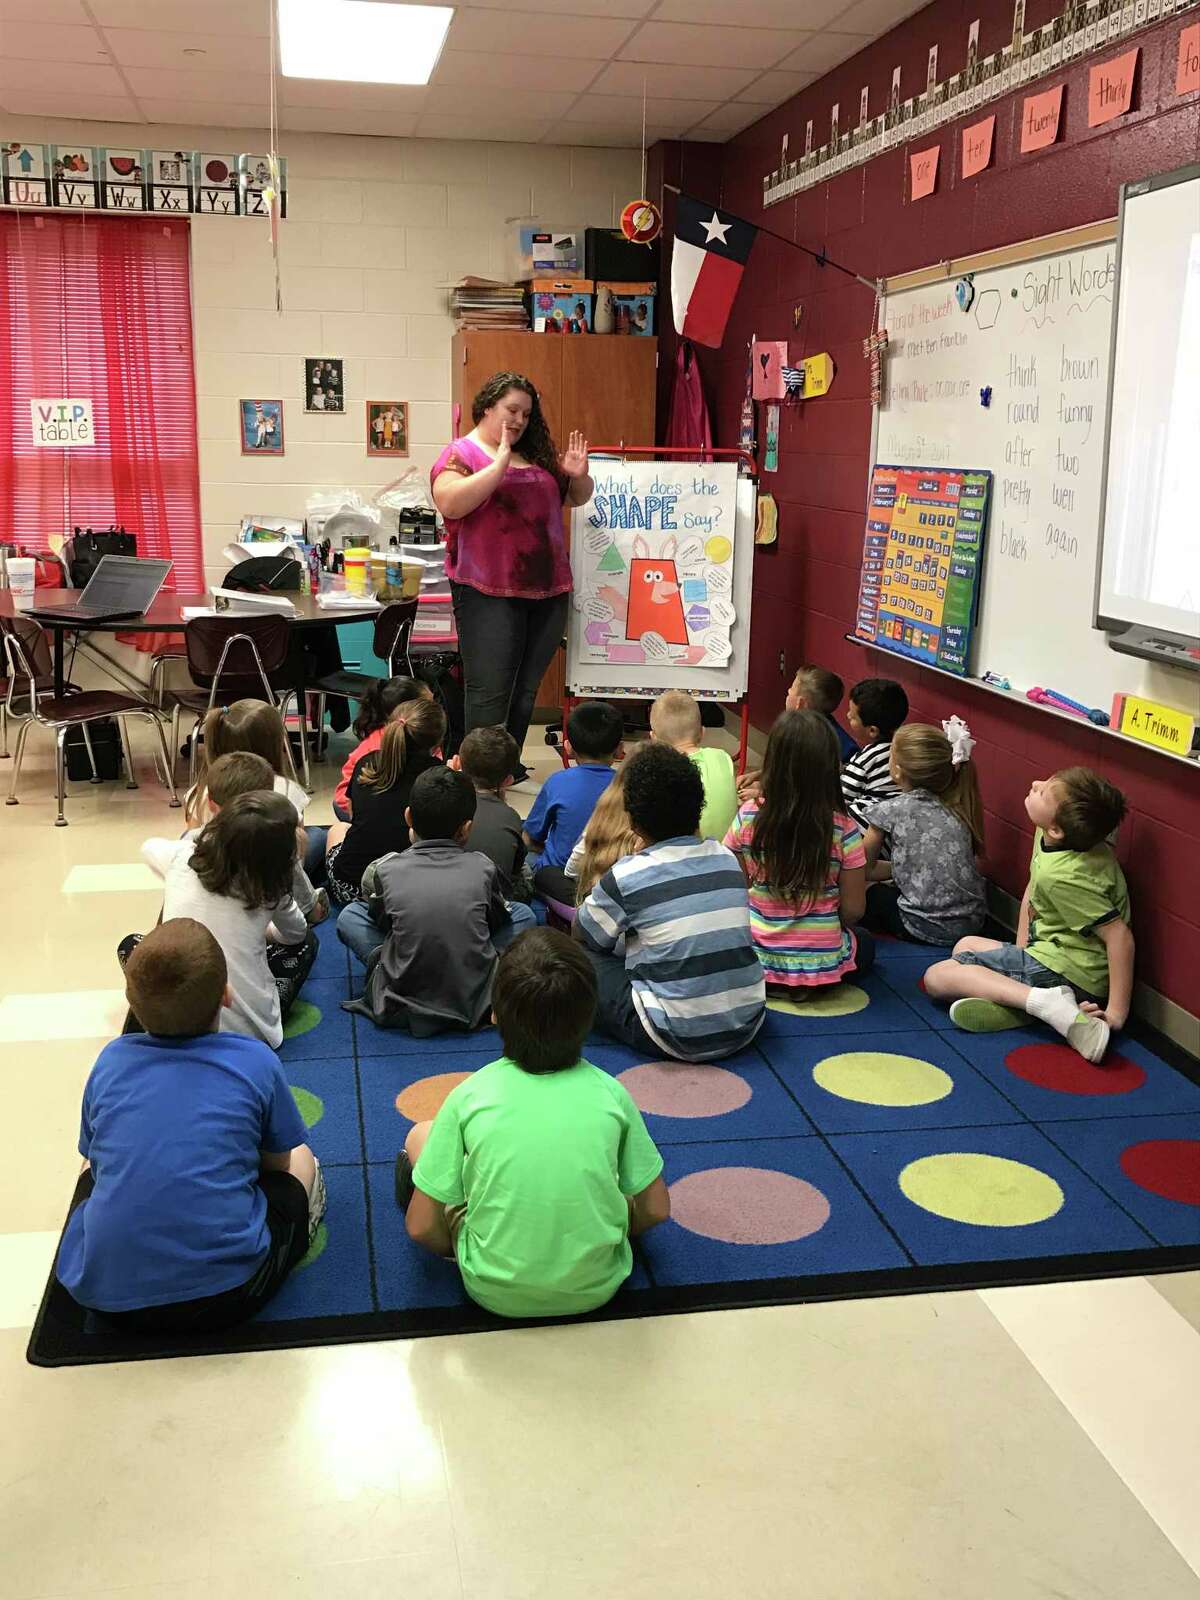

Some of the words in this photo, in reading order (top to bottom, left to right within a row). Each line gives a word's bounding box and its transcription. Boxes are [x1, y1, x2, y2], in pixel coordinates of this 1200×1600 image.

[1110, 13, 1120, 31] 49
[1182, 41, 1200, 77] fo
[1096, 78, 1127, 111] thirty
[15, 182, 41, 203] Uu
[63, 185, 86, 206] Vv
[110, 187, 136, 209] Ww
[160, 189, 181, 210] Xx
[207, 191, 229, 213] Yy
[1023, 263, 1064, 313] Sight
[1069, 253, 1115, 297] Words
[1006, 353, 1037, 388] think
[1060, 344, 1099, 382] brown
[38, 404, 88, 423] V.I.P.
[1007, 396, 1039, 424] round
[1057, 393, 1093, 445] funny
[39, 422, 88, 442] table
[1005, 435, 1034, 467] after
[1056, 437, 1079, 475] two
[594, 474, 638, 495] What
[650, 474, 682, 496] does
[692, 477, 720, 496] the
[1004, 479, 1032, 523] pretty
[1052, 483, 1074, 512] well
[588, 495, 678, 530] SHAPE
[1000, 520, 1027, 561] black
[1046, 523, 1078, 560] again
[1131, 709, 1140, 728] A.
[1145, 712, 1180, 744] Trimm
